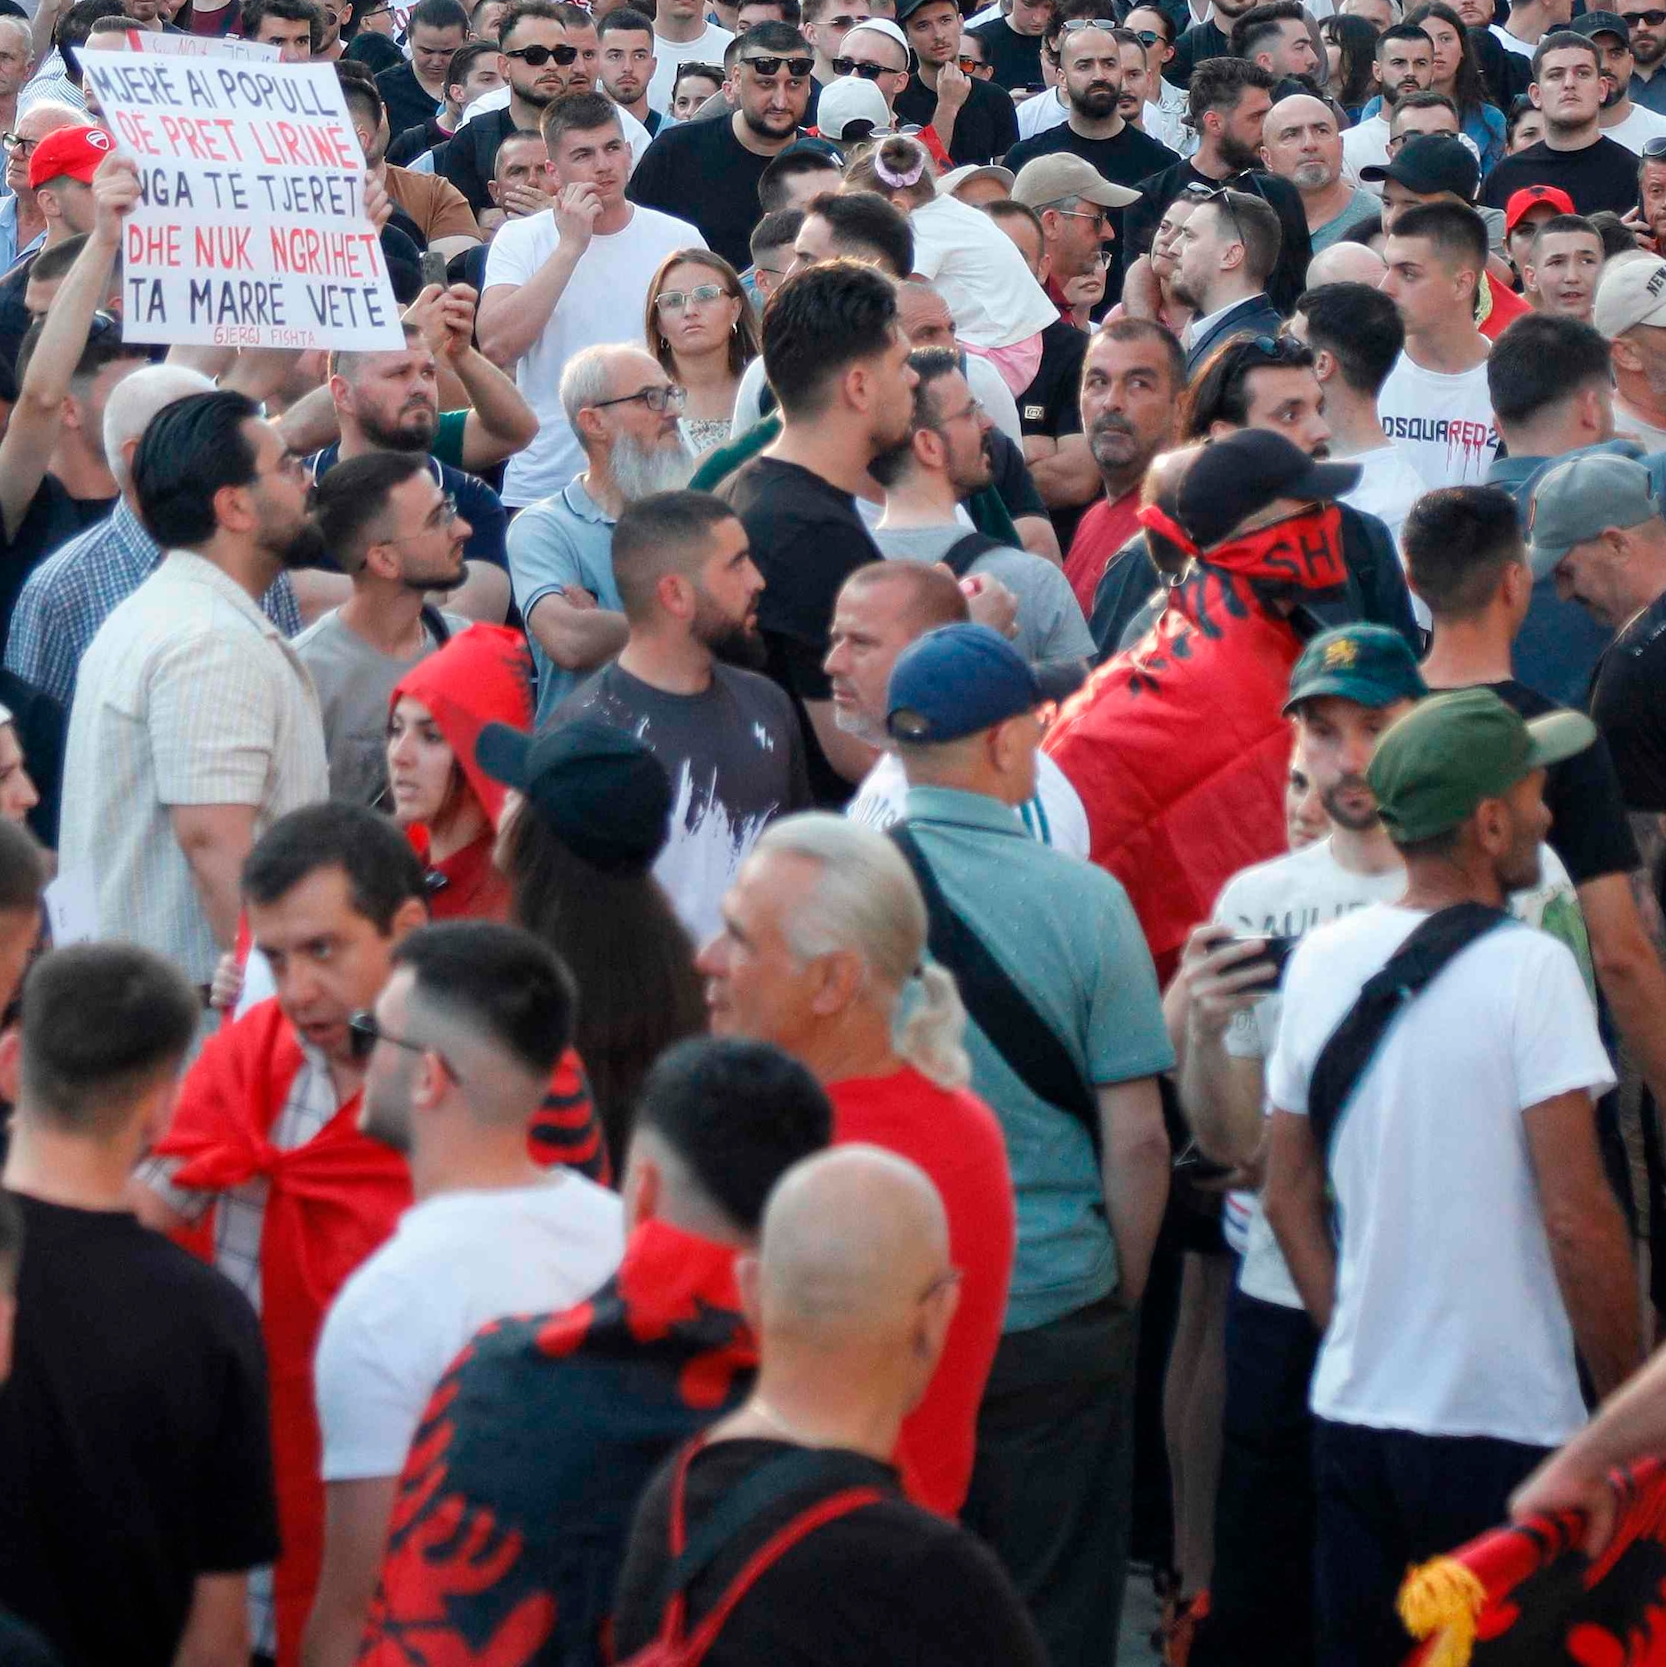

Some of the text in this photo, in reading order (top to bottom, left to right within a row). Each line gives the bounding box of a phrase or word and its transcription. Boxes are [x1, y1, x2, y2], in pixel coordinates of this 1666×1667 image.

[90, 61, 338, 117] MJERË AI POPULL
[159, 113, 244, 163] PRET
[251, 119, 359, 171] LIRINË
[137, 168, 357, 218] NGA TË TJERËT
[128, 223, 380, 278] DHE NUK NGRIHET
[129, 275, 386, 329] TA MARRË VETË
[271, 329, 316, 347] FISHTA
